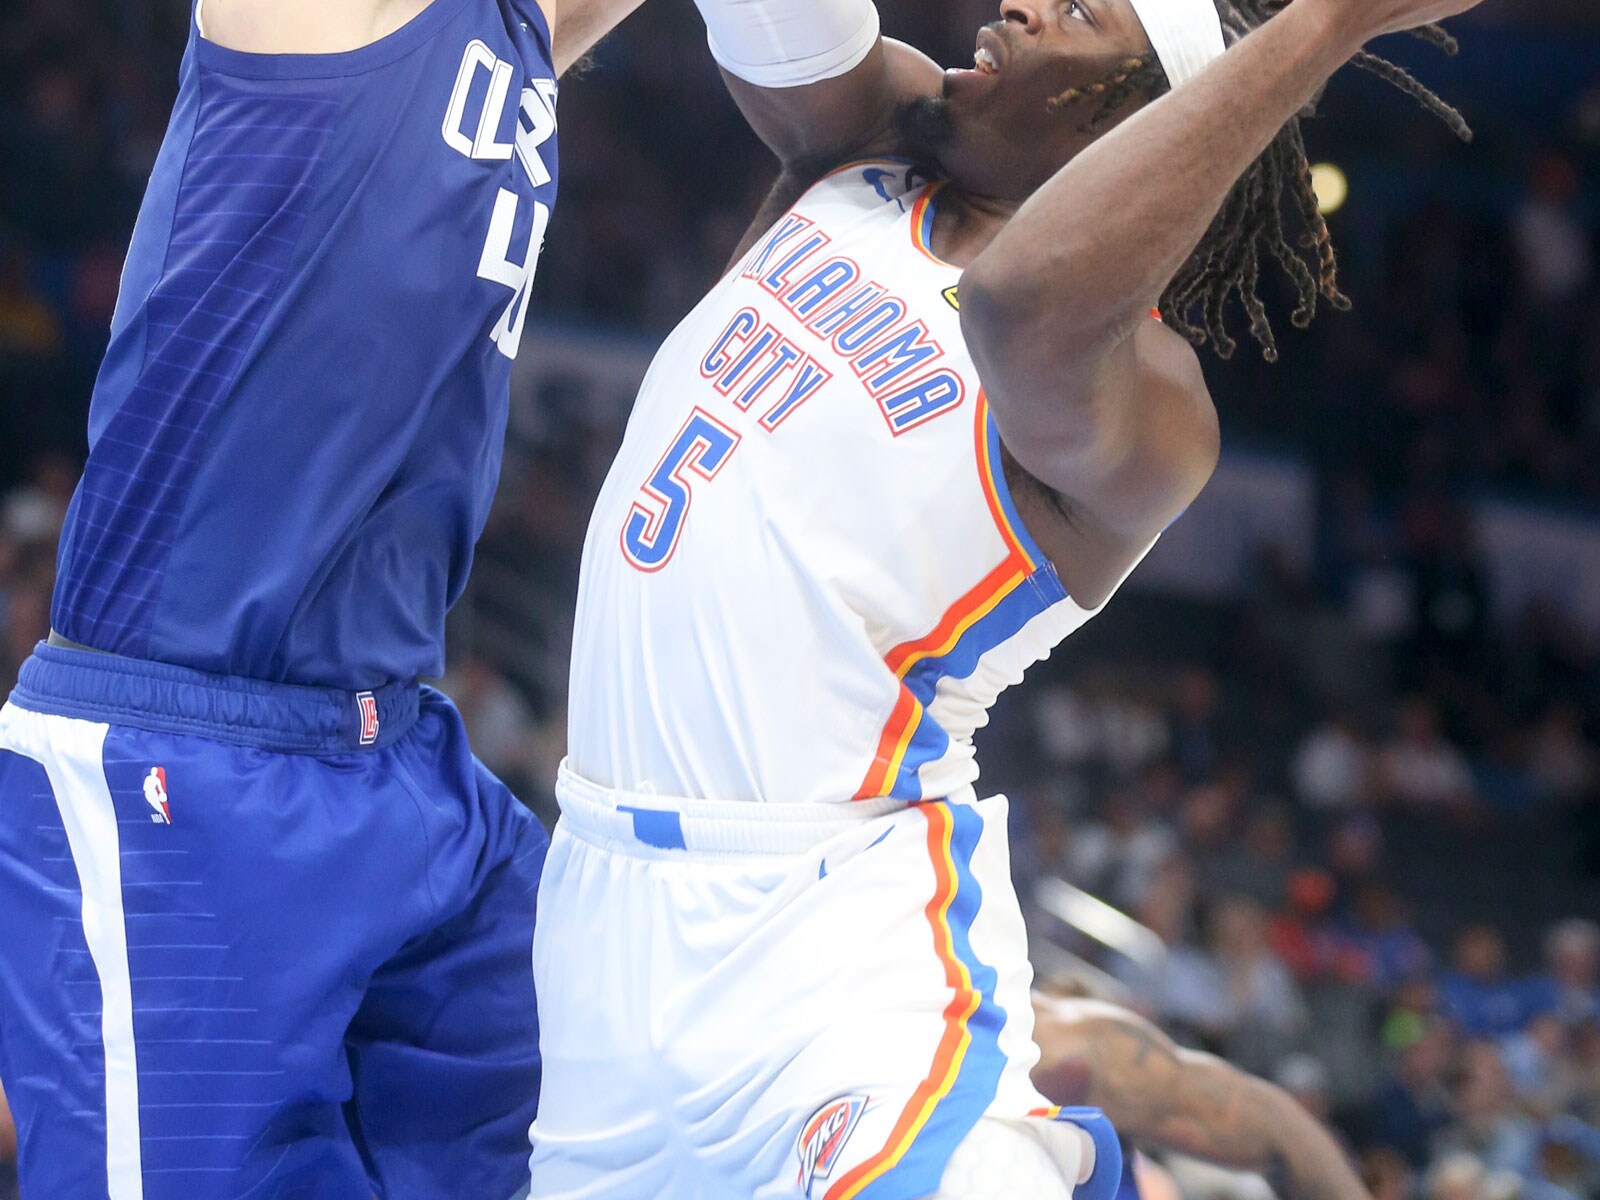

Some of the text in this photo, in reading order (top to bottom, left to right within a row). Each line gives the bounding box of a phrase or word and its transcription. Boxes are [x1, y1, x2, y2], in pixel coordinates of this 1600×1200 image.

[700, 306, 833, 433] CITY
[742, 211, 965, 437] KLAHOMA
[620, 405, 742, 573] 5
